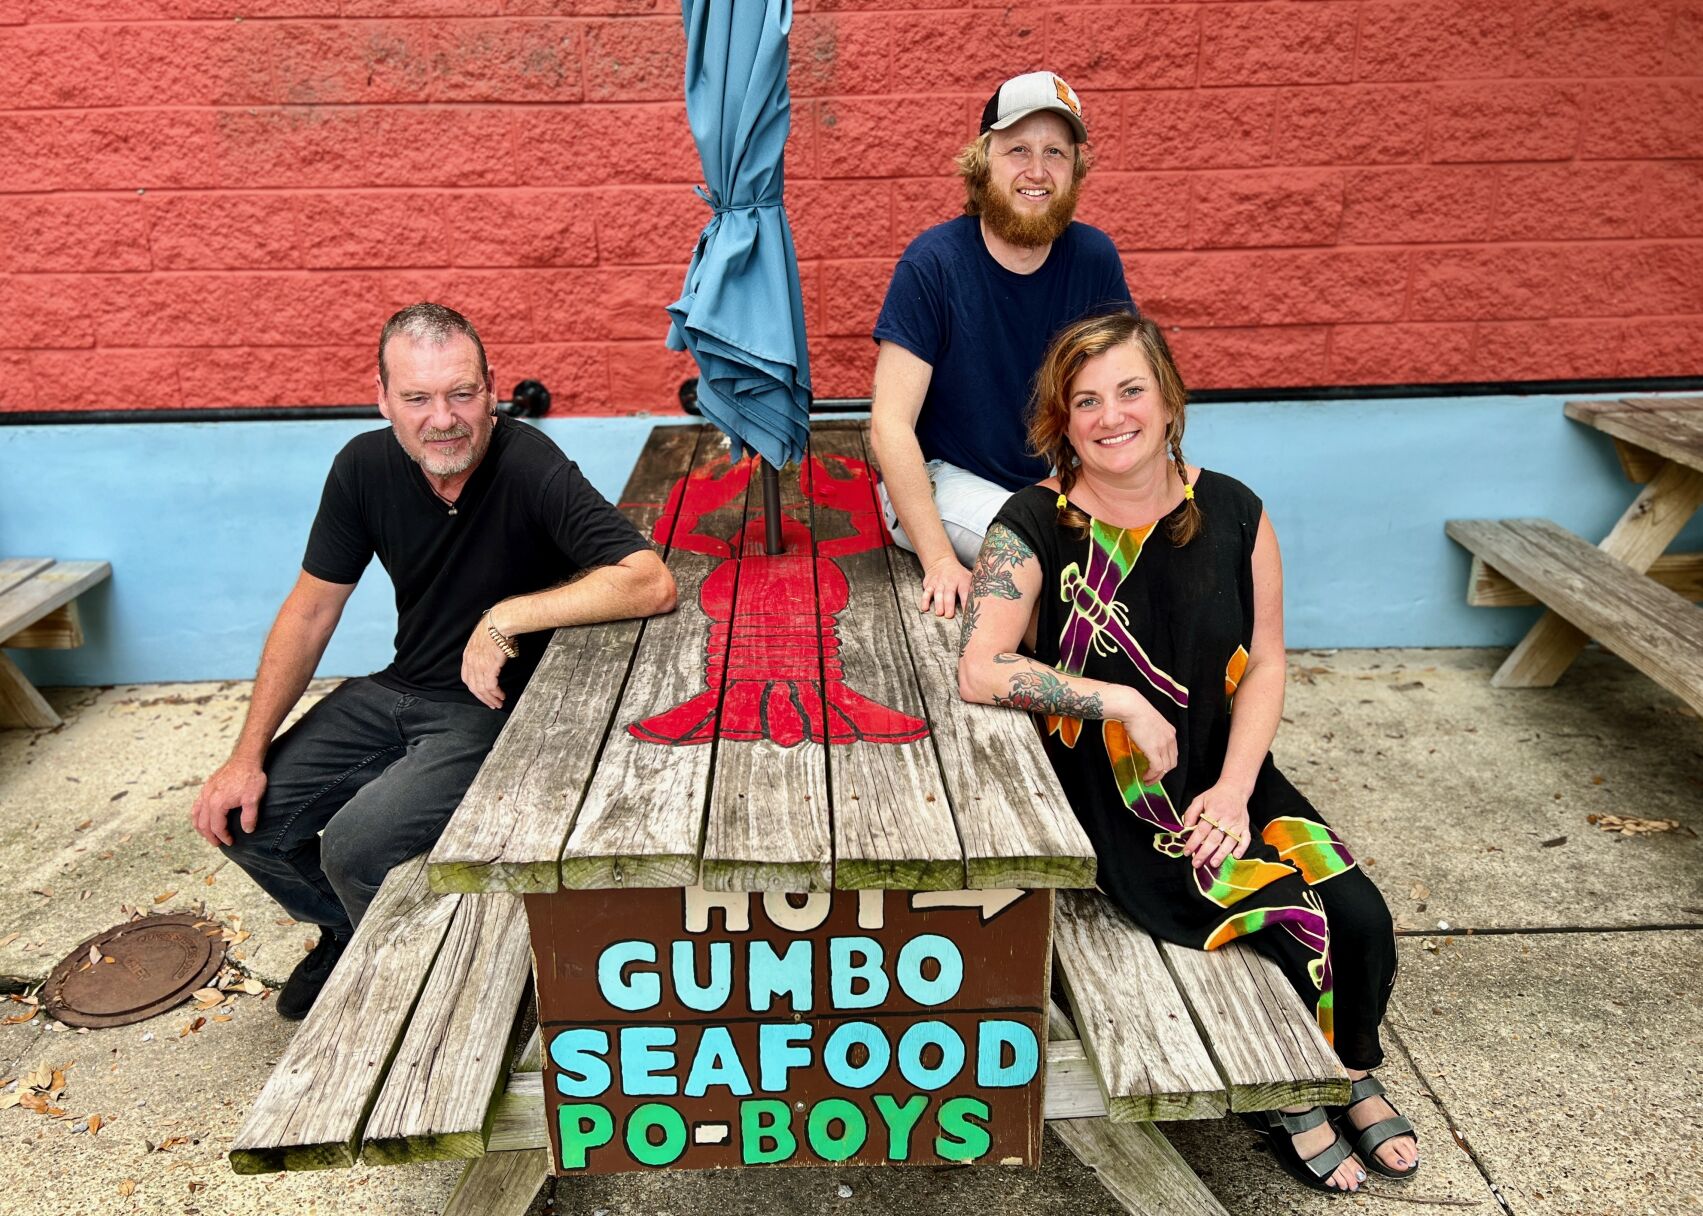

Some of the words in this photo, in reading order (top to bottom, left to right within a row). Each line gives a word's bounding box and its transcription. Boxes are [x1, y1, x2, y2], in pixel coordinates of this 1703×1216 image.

[597, 933, 964, 1013] GUMBO
[549, 1020, 1040, 1098] SEAFOOD
[556, 1094, 993, 1170] PO-BOYS
